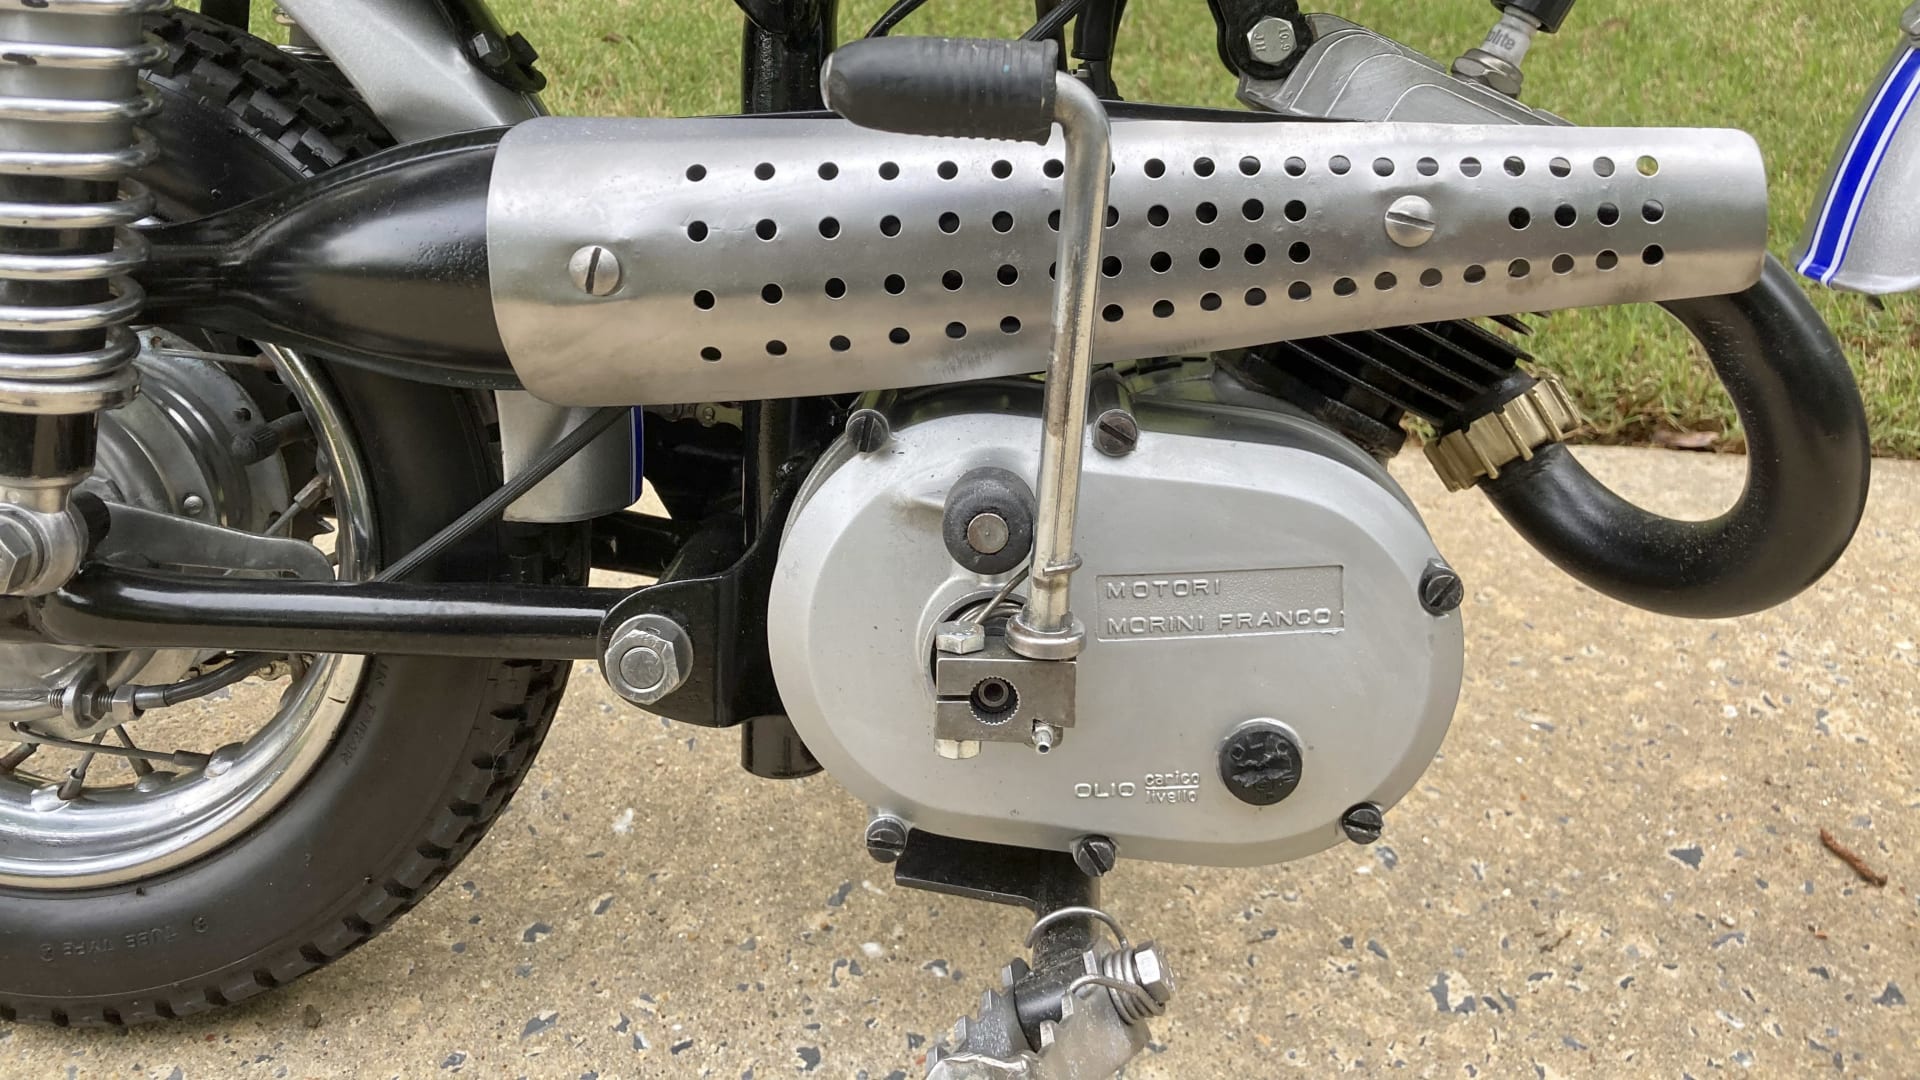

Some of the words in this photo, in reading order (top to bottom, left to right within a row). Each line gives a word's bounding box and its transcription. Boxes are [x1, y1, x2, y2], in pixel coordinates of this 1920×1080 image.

[1106, 578, 1221, 600] MOTORI
[1106, 614, 1205, 635] MORINI
[1217, 607, 1333, 630] FRANCO
[1144, 769, 1200, 786] carico
[1073, 782, 1137, 798] OLIO
